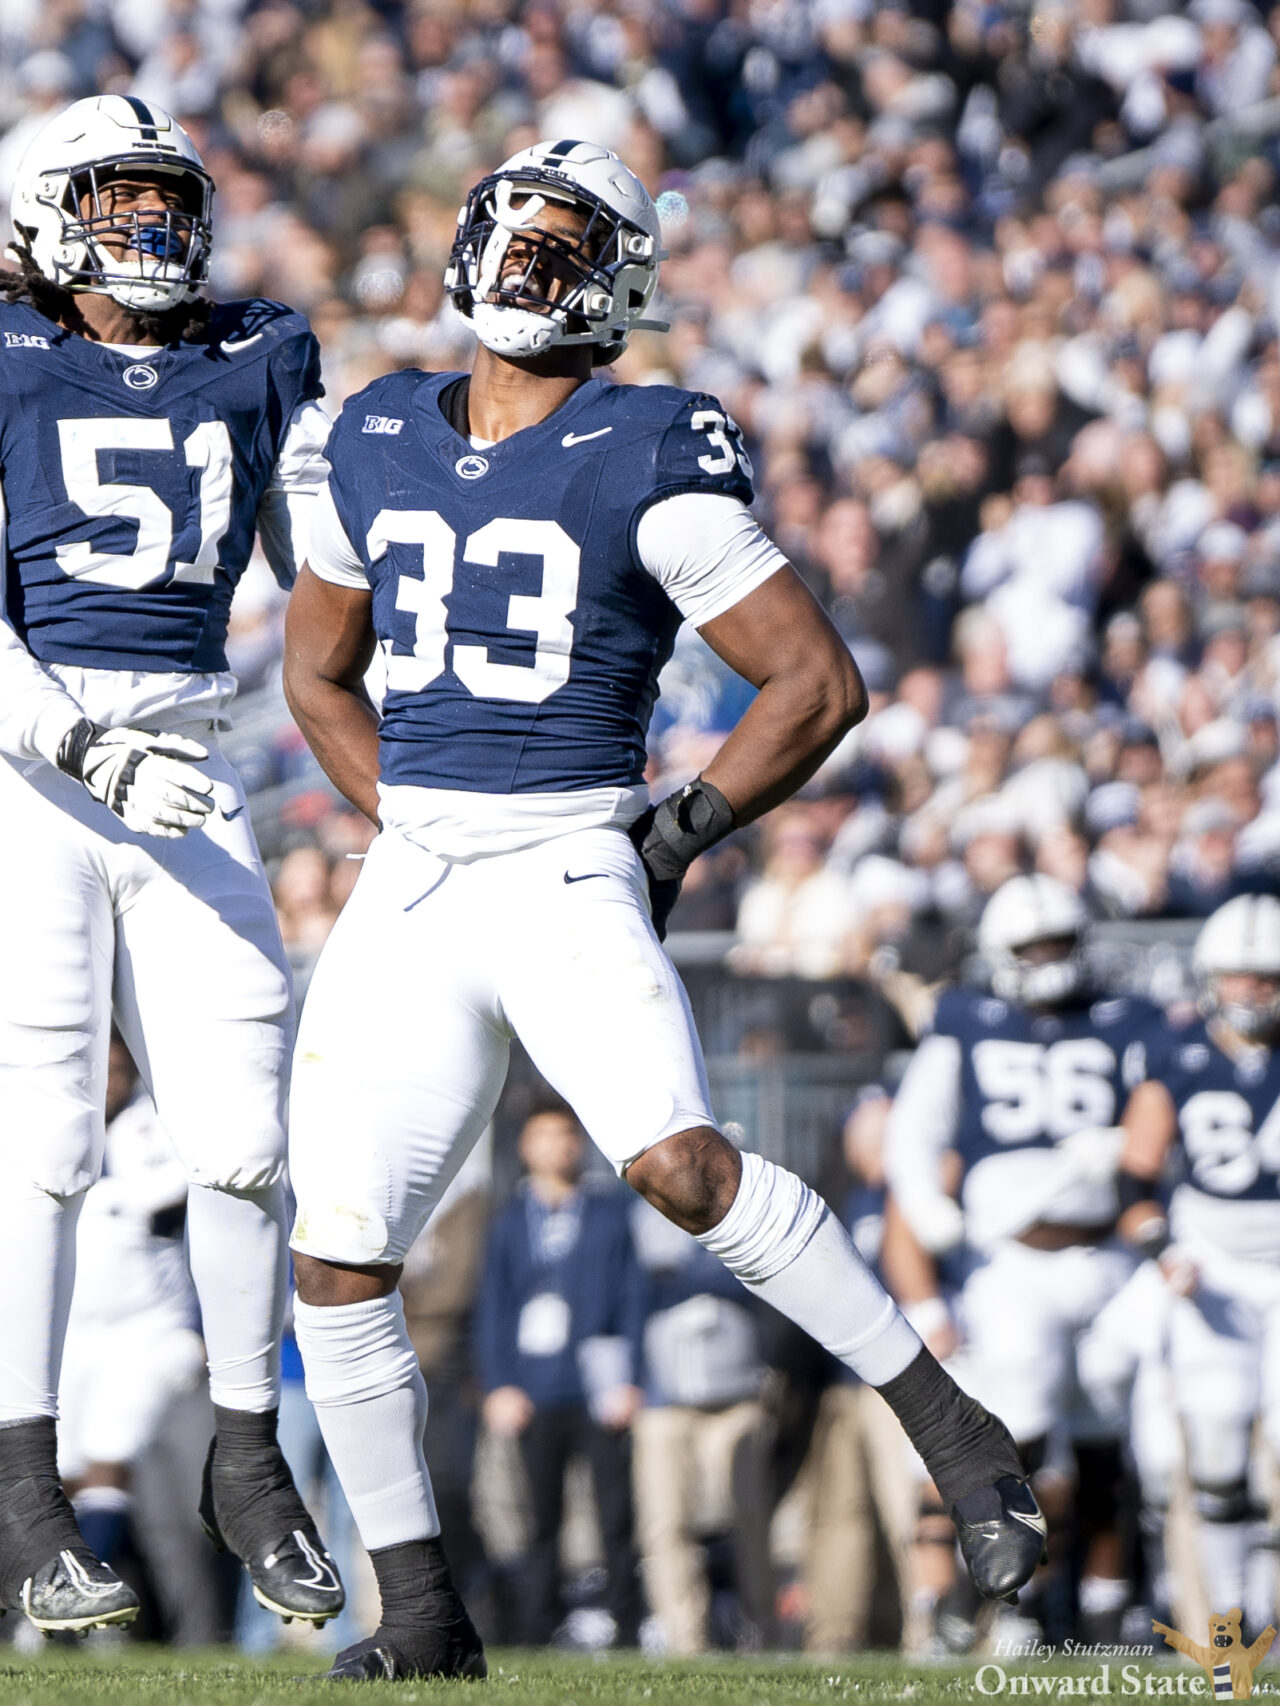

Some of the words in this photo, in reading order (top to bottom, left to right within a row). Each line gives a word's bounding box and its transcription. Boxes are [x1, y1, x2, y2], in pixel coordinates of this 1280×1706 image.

[55, 418, 234, 590] 51
[366, 509, 581, 704] 33
[972, 1037, 1117, 1144] 56
